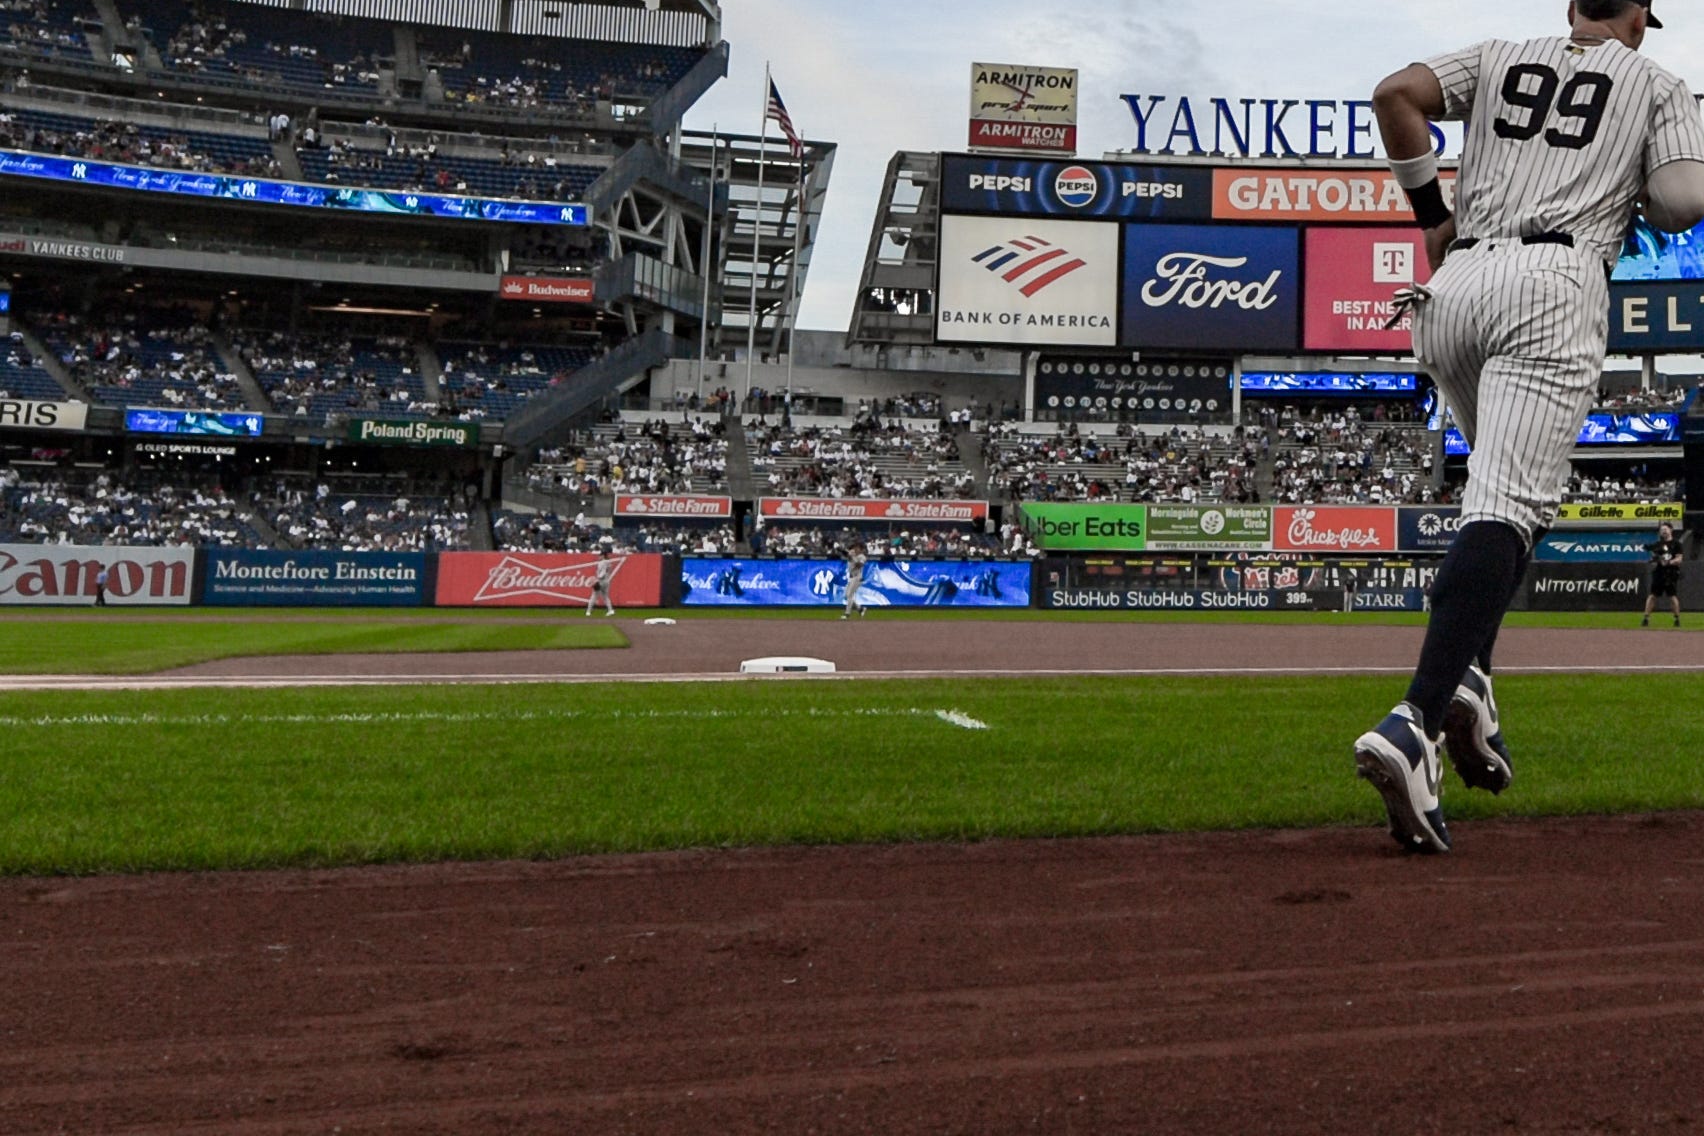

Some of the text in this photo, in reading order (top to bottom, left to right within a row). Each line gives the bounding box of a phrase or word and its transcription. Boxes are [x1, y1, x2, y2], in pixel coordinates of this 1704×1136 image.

[976, 71, 1073, 89] ARMITRON
[1493, 62, 1613, 150] 99
[979, 123, 1067, 138] ARMITRON
[1022, 137, 1064, 147] WATCHES
[969, 174, 1031, 192] PEPSI
[1057, 181, 1094, 192] PEPSI
[1122, 182, 1183, 198] PEPSI
[1228, 177, 1456, 212] GATORAE
[32, 240, 90, 259] YANKEES
[93, 246, 124, 261] CLUB
[1141, 252, 1282, 310] Ford
[528, 283, 590, 298] Budweiser
[1333, 301, 1371, 314] BEST
[942, 311, 1110, 328] BANK OF AMERICA
[1347, 316, 1363, 330] IN
[361, 420, 467, 444] Poland Spring
[169, 445, 201, 454] SPORTS
[203, 446, 236, 455] LOUNGE
[1578, 507, 1623, 518] Gillette
[1634, 506, 1679, 518] Gillette
[1026, 515, 1140, 537] Uber Eats
[1288, 512, 1380, 548] Chick-fil-A
[1574, 544, 1645, 553] AMTRAK
[214, 560, 416, 580] Montefiore Einstein
[488, 566, 598, 589] Budweise
[358, 585, 387, 593] Human
[389, 585, 415, 593] Health
[1535, 577, 1639, 593] NITTOTIRE.COM
[1052, 591, 1269, 607] StubHub StubHub StubHub
[1355, 593, 1406, 607] STARR
